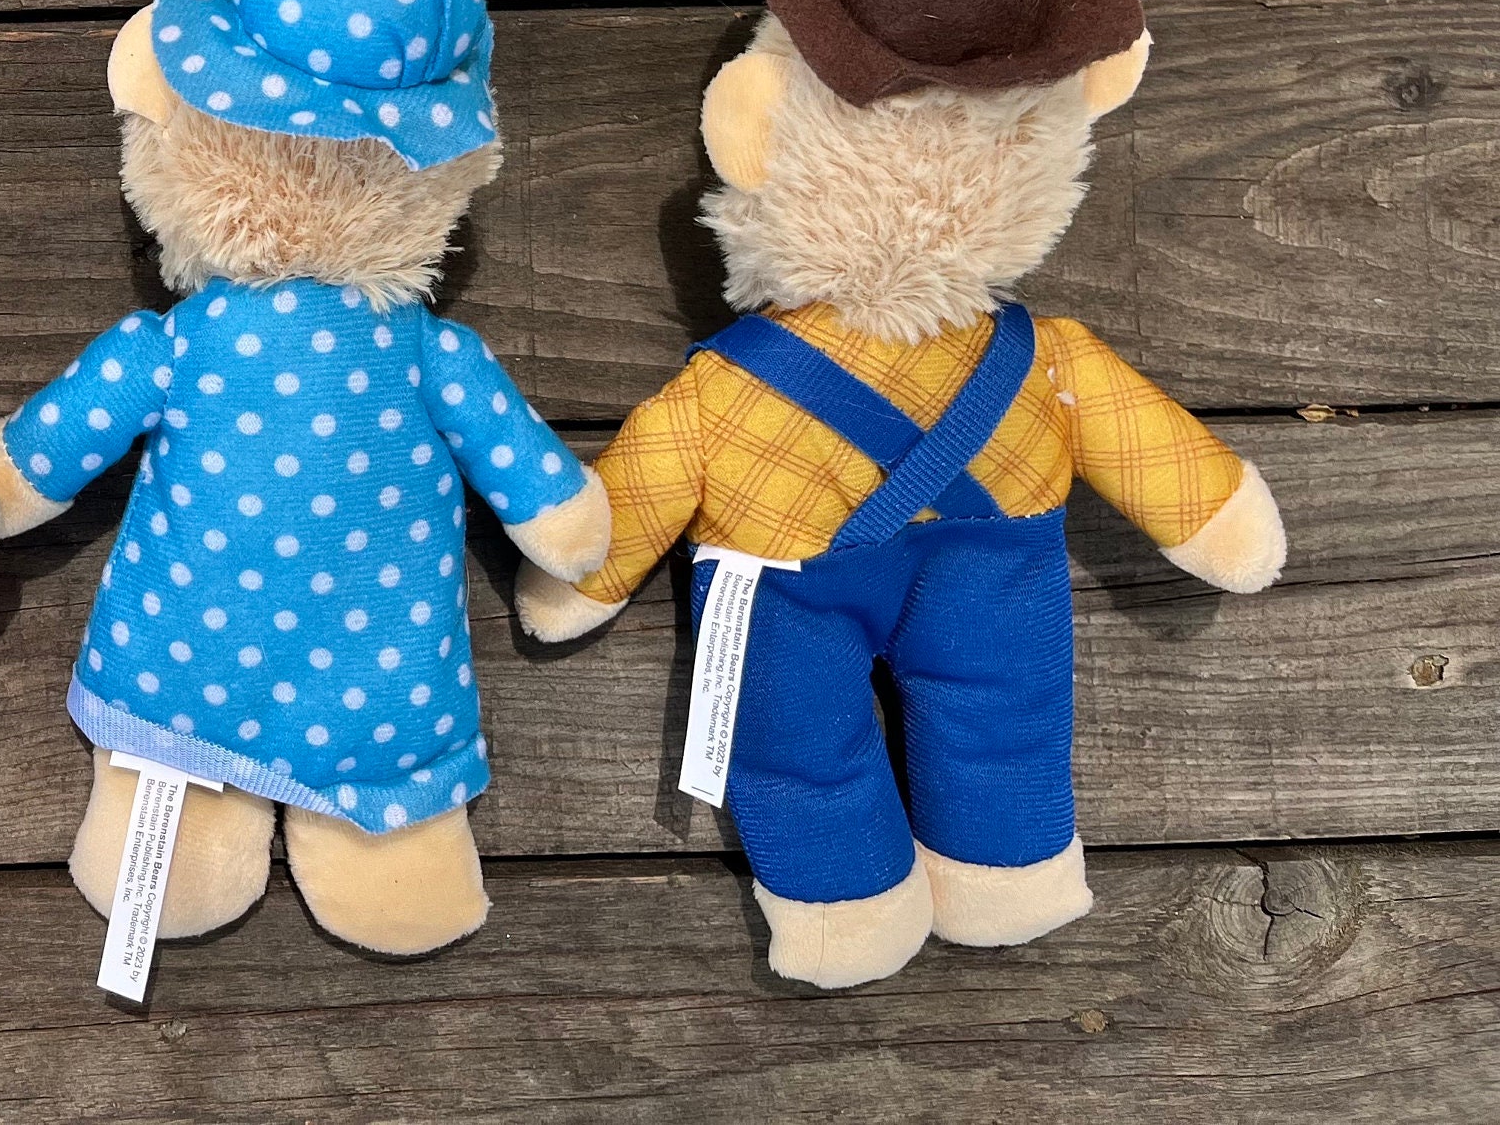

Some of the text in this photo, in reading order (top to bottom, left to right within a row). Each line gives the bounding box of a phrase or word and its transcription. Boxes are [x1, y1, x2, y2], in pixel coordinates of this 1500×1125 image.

[725, 574, 742, 622] Berenstain
[741, 578, 754, 594] The
[703, 571, 734, 694] Berenstain Enterprises, Inc.
[734, 598, 749, 651] Berenstain
[729, 653, 740, 681] Bears
[708, 694, 723, 742] Trademark
[720, 684, 737, 732] Copyright
[706, 745, 715, 760] TM
[716, 740, 727, 764] 2023
[713, 765, 721, 778] by
[150, 781, 168, 831] Berenstain
[166, 784, 179, 802] The
[123, 778, 157, 903] Berenstain Enterprises, Inc.
[156, 805, 175, 859] Berenstain
[151, 862, 164, 890] Bears
[127, 903, 143, 948] Trademark
[141, 891, 157, 936] Copyright
[123, 950, 135, 966] TM
[130, 970, 143, 982] by
[135, 946, 148, 970] 2023
